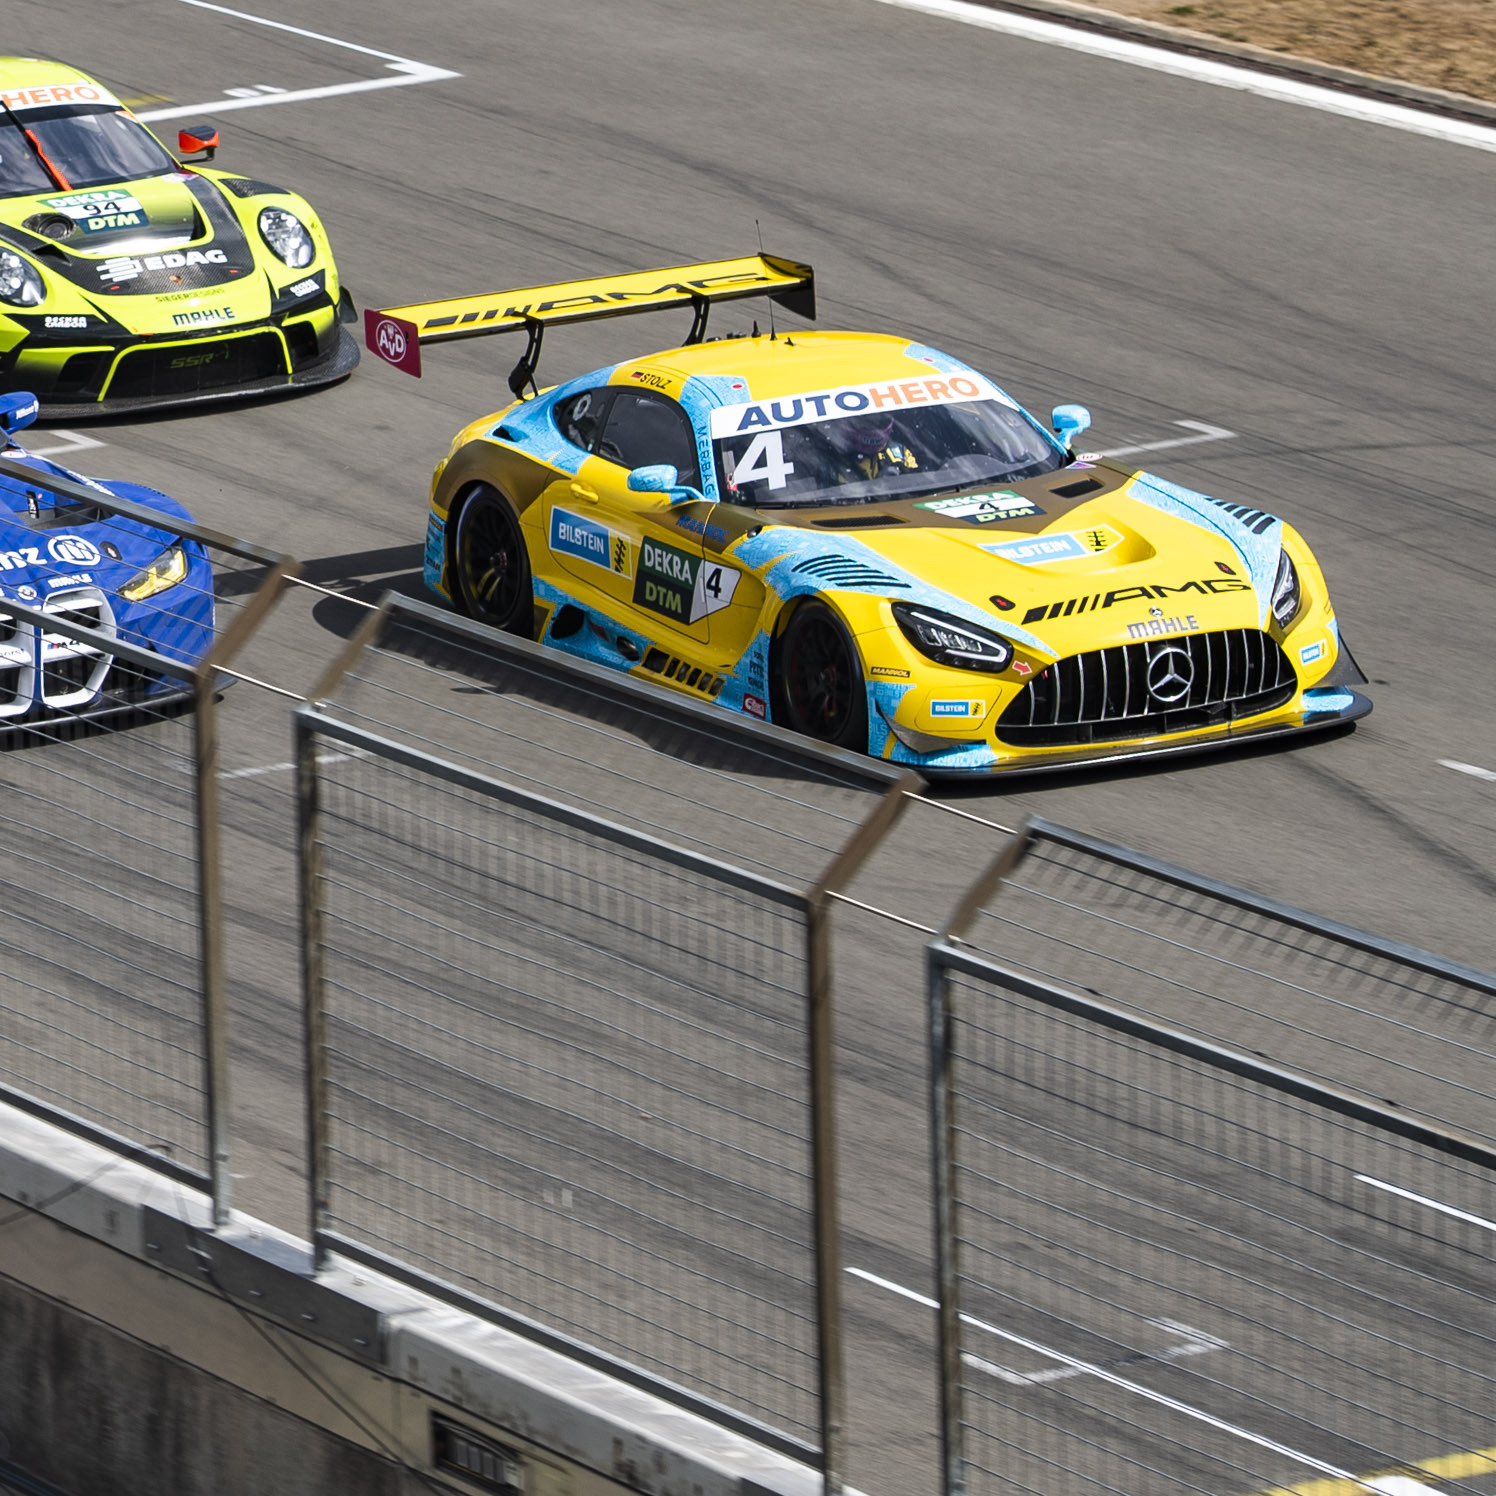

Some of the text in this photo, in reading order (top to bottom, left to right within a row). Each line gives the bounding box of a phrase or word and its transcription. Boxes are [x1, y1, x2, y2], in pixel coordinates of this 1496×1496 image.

[45, 189, 129, 208] DEKRA
[82, 201, 123, 218] 94
[86, 211, 141, 232] DTM
[145, 248, 229, 272] EDAG
[530, 272, 774, 312] AMG
[171, 305, 237, 328] MAHLE
[639, 371, 672, 391] STOLZ
[735, 376, 983, 432] AUTOHERO
[695, 424, 716, 496] MERBAG
[731, 429, 796, 491] 4
[923, 491, 1017, 511] DEKRA
[976, 501, 1002, 513] 4
[975, 506, 1035, 524] DTM
[558, 522, 606, 555] BILSTEIN
[994, 538, 1074, 562] BILSTEIN
[643, 544, 723, 599] DEKRA 4
[645, 581, 683, 615] DTM
[1100, 579, 1253, 609] AMG
[1126, 613, 1201, 639] MAHLE
[871, 666, 911, 677] MANNOL
[934, 703, 967, 714] BILSTEIN
